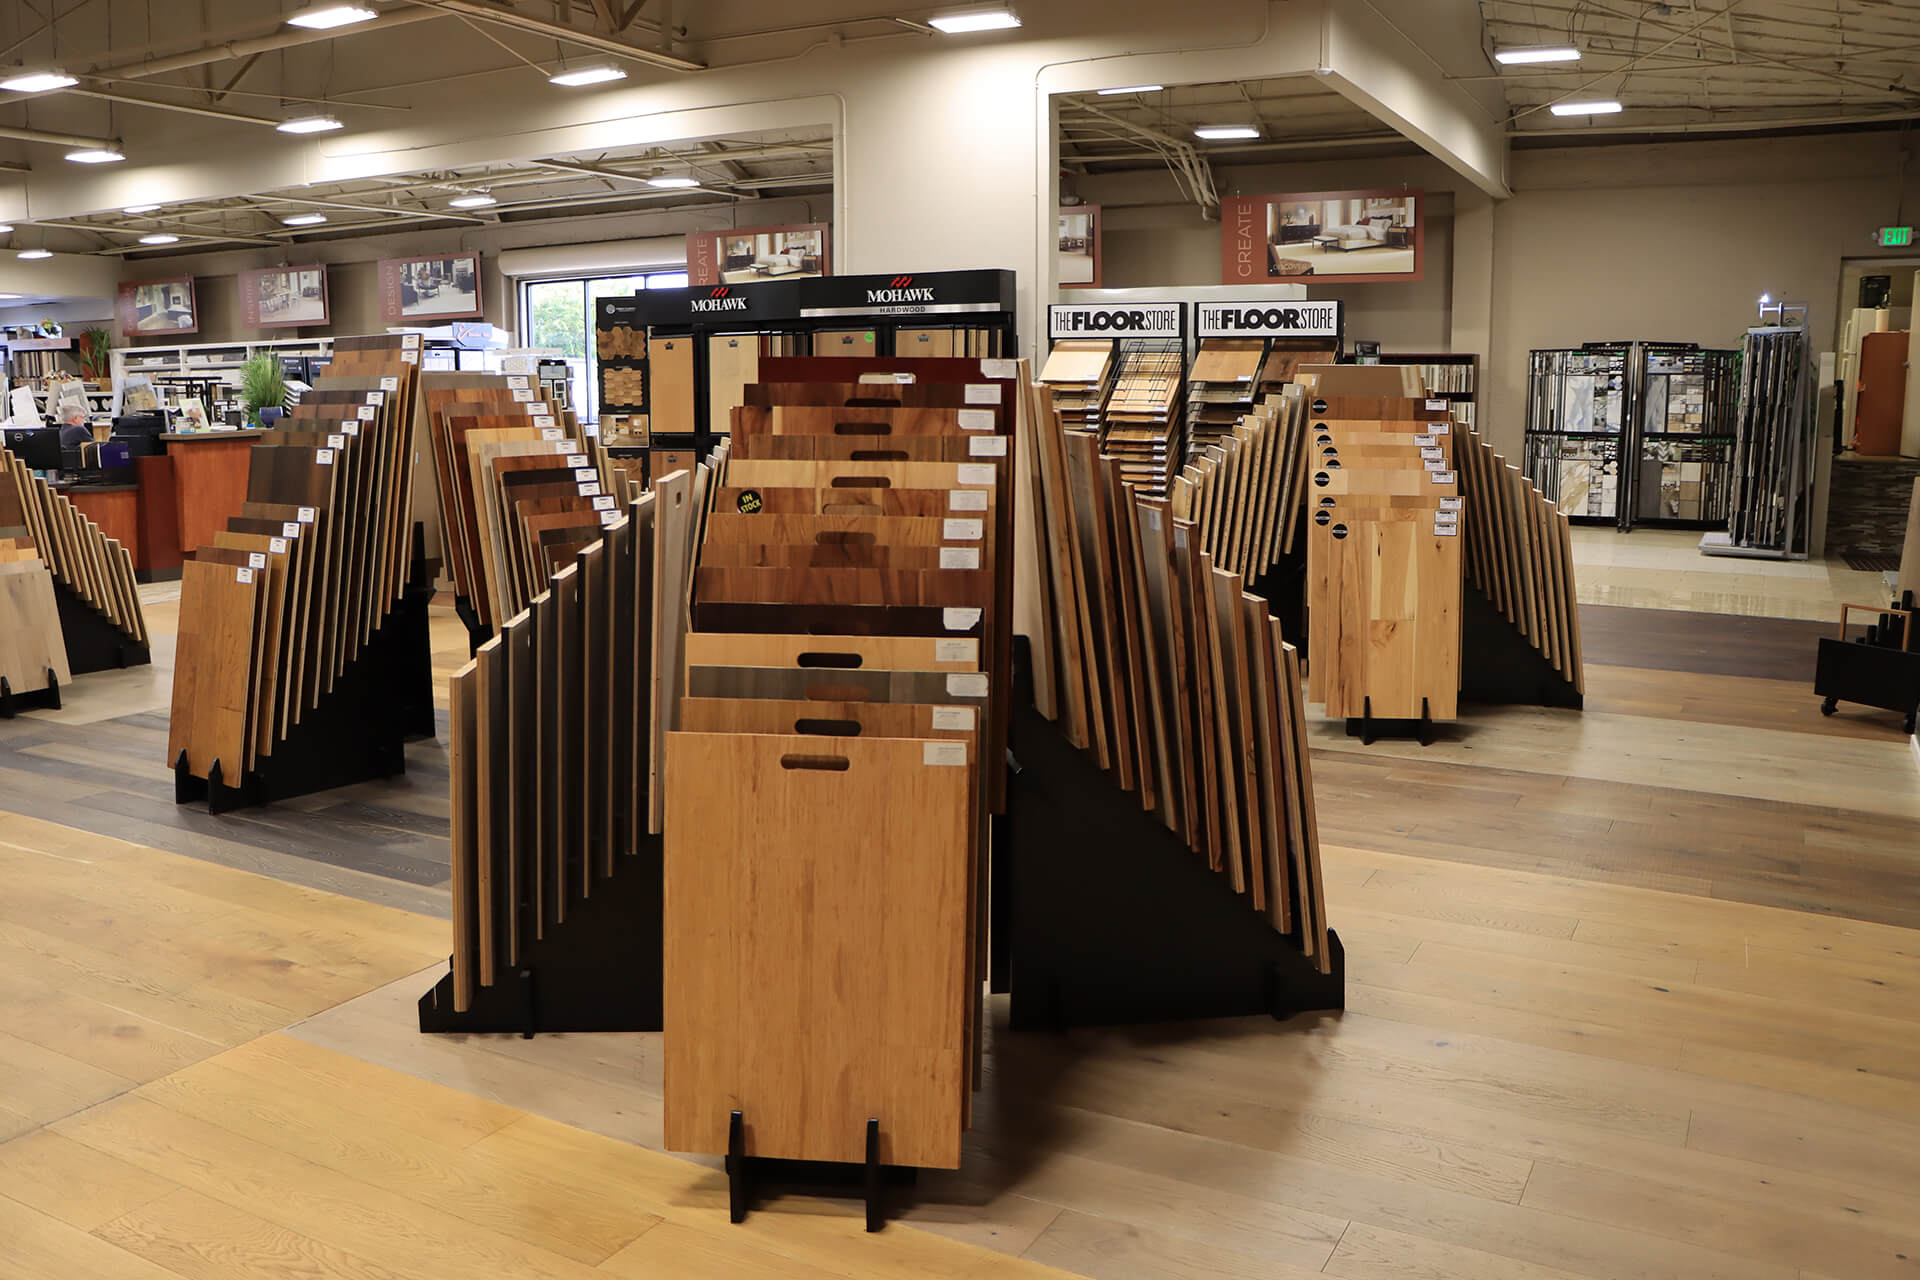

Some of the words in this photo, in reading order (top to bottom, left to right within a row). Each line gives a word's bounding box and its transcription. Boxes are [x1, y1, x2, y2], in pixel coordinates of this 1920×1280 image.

[1238, 203, 1252, 277] CREATE
[1884, 227, 1910, 245] EXIT
[697, 239, 709, 285] REATE
[384, 265, 397, 316] DESIGN
[867, 288, 935, 303] MOHAWK
[691, 298, 747, 312] MOHAWK
[1054, 311, 1071, 331] THE
[1071, 310, 1145, 331] FLOOR
[1145, 310, 1176, 331] STORE
[1202, 309, 1221, 330] THE
[1221, 308, 1301, 330] FLOOR
[1300, 308, 1333, 330] STORE
[742, 493, 753, 503] IN
